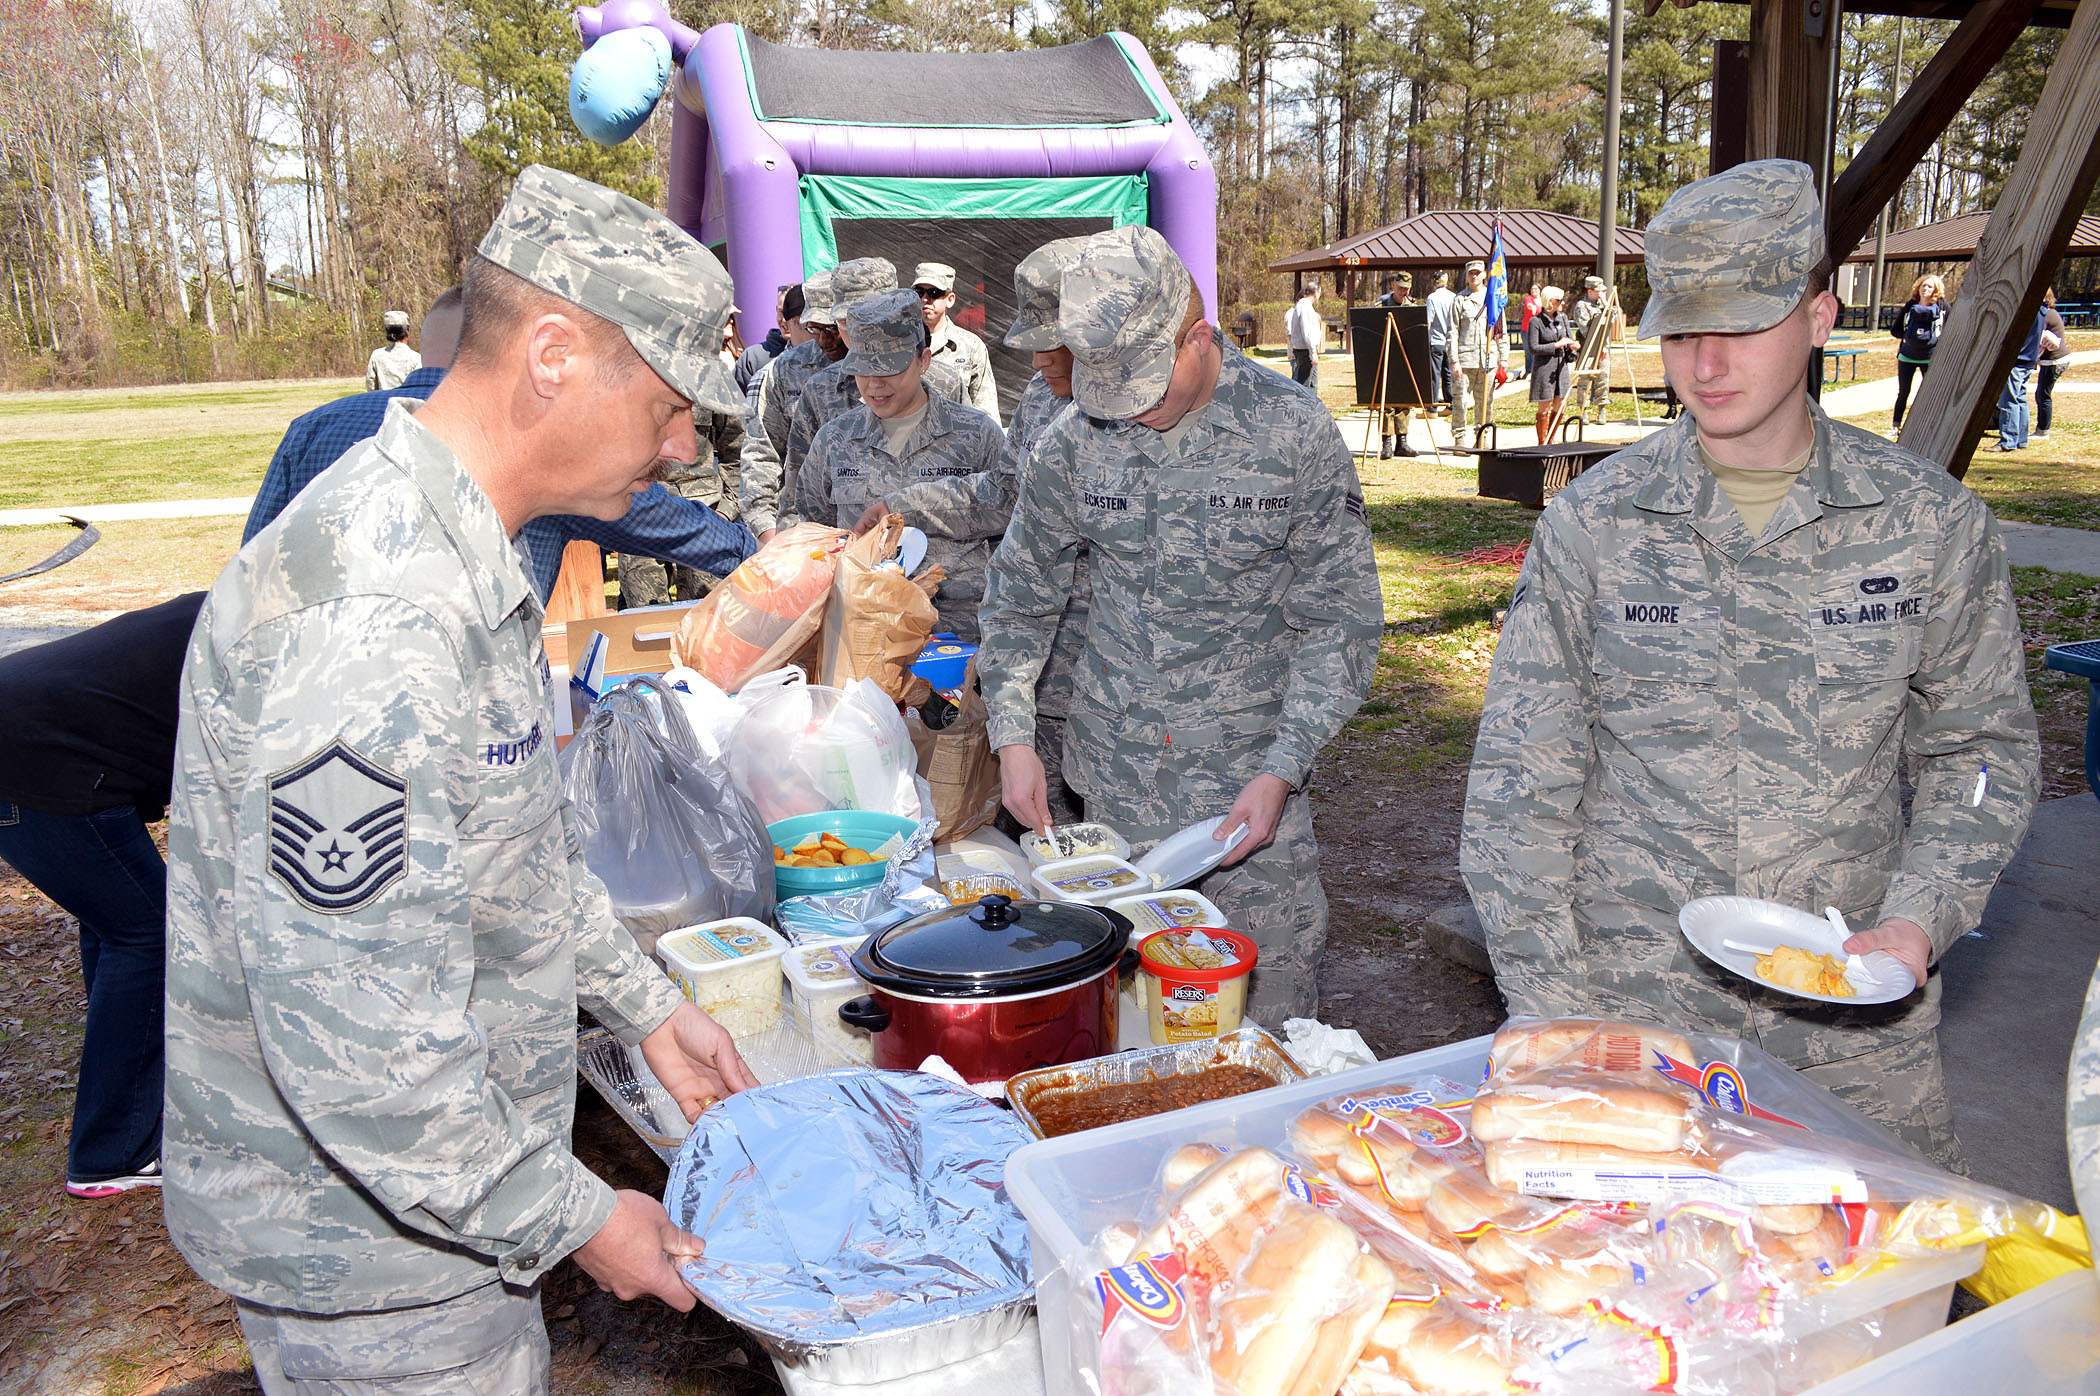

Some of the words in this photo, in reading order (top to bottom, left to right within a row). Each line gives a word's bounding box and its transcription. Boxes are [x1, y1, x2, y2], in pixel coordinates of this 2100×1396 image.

[1345, 257, 1360, 265] 413
[836, 468, 860, 477] SANTOS
[920, 468, 934, 476] U.S.
[936, 468, 948, 476] AIR
[949, 468, 971, 477] FORCE
[1084, 492, 1127, 511] ECKSTEIN
[1209, 495, 1229, 508] U.S.
[1233, 497, 1253, 509] AIR
[1258, 496, 1290, 511] FORCE
[1625, 604, 1680, 624] MOORE
[1822, 608, 1851, 626] U.S.
[1858, 603, 1887, 624] AIR
[1606, 1034, 1641, 1051] HOT
[1525, 1170, 1572, 1178] Nutrition
[1525, 1180, 1556, 1188] Facts
